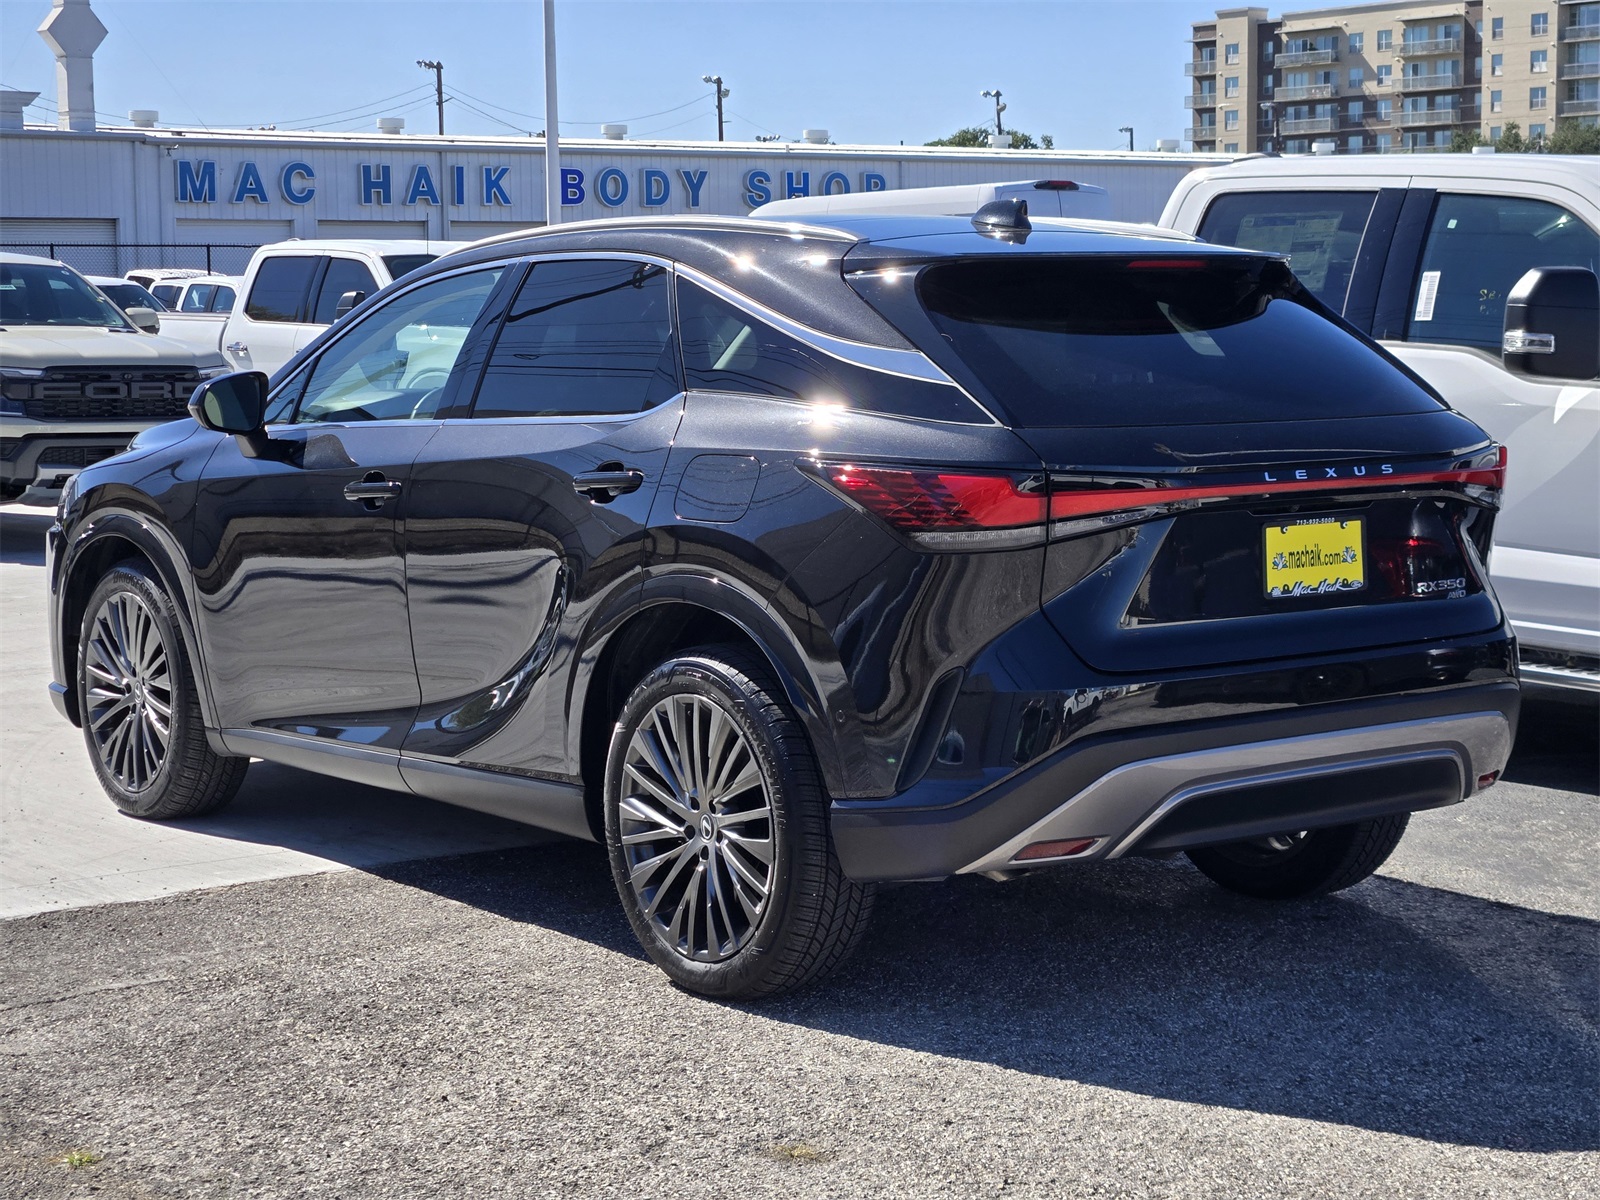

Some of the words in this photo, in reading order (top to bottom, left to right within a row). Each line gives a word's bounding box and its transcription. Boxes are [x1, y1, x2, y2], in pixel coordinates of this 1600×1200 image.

[175, 159, 316, 205] MAC
[359, 163, 513, 206] HAIK
[559, 167, 709, 209] BODY
[746, 169, 887, 208] SHOP
[1264, 464, 1394, 482] LEXUS
[1288, 544, 1341, 569] machaik.com
[113, 570, 162, 615] BRIDGESTONE
[1292, 580, 1317, 597] Mac
[1318, 577, 1343, 594] Haik
[1416, 577, 1466, 593] RX350
[1447, 589, 1467, 600] AWD
